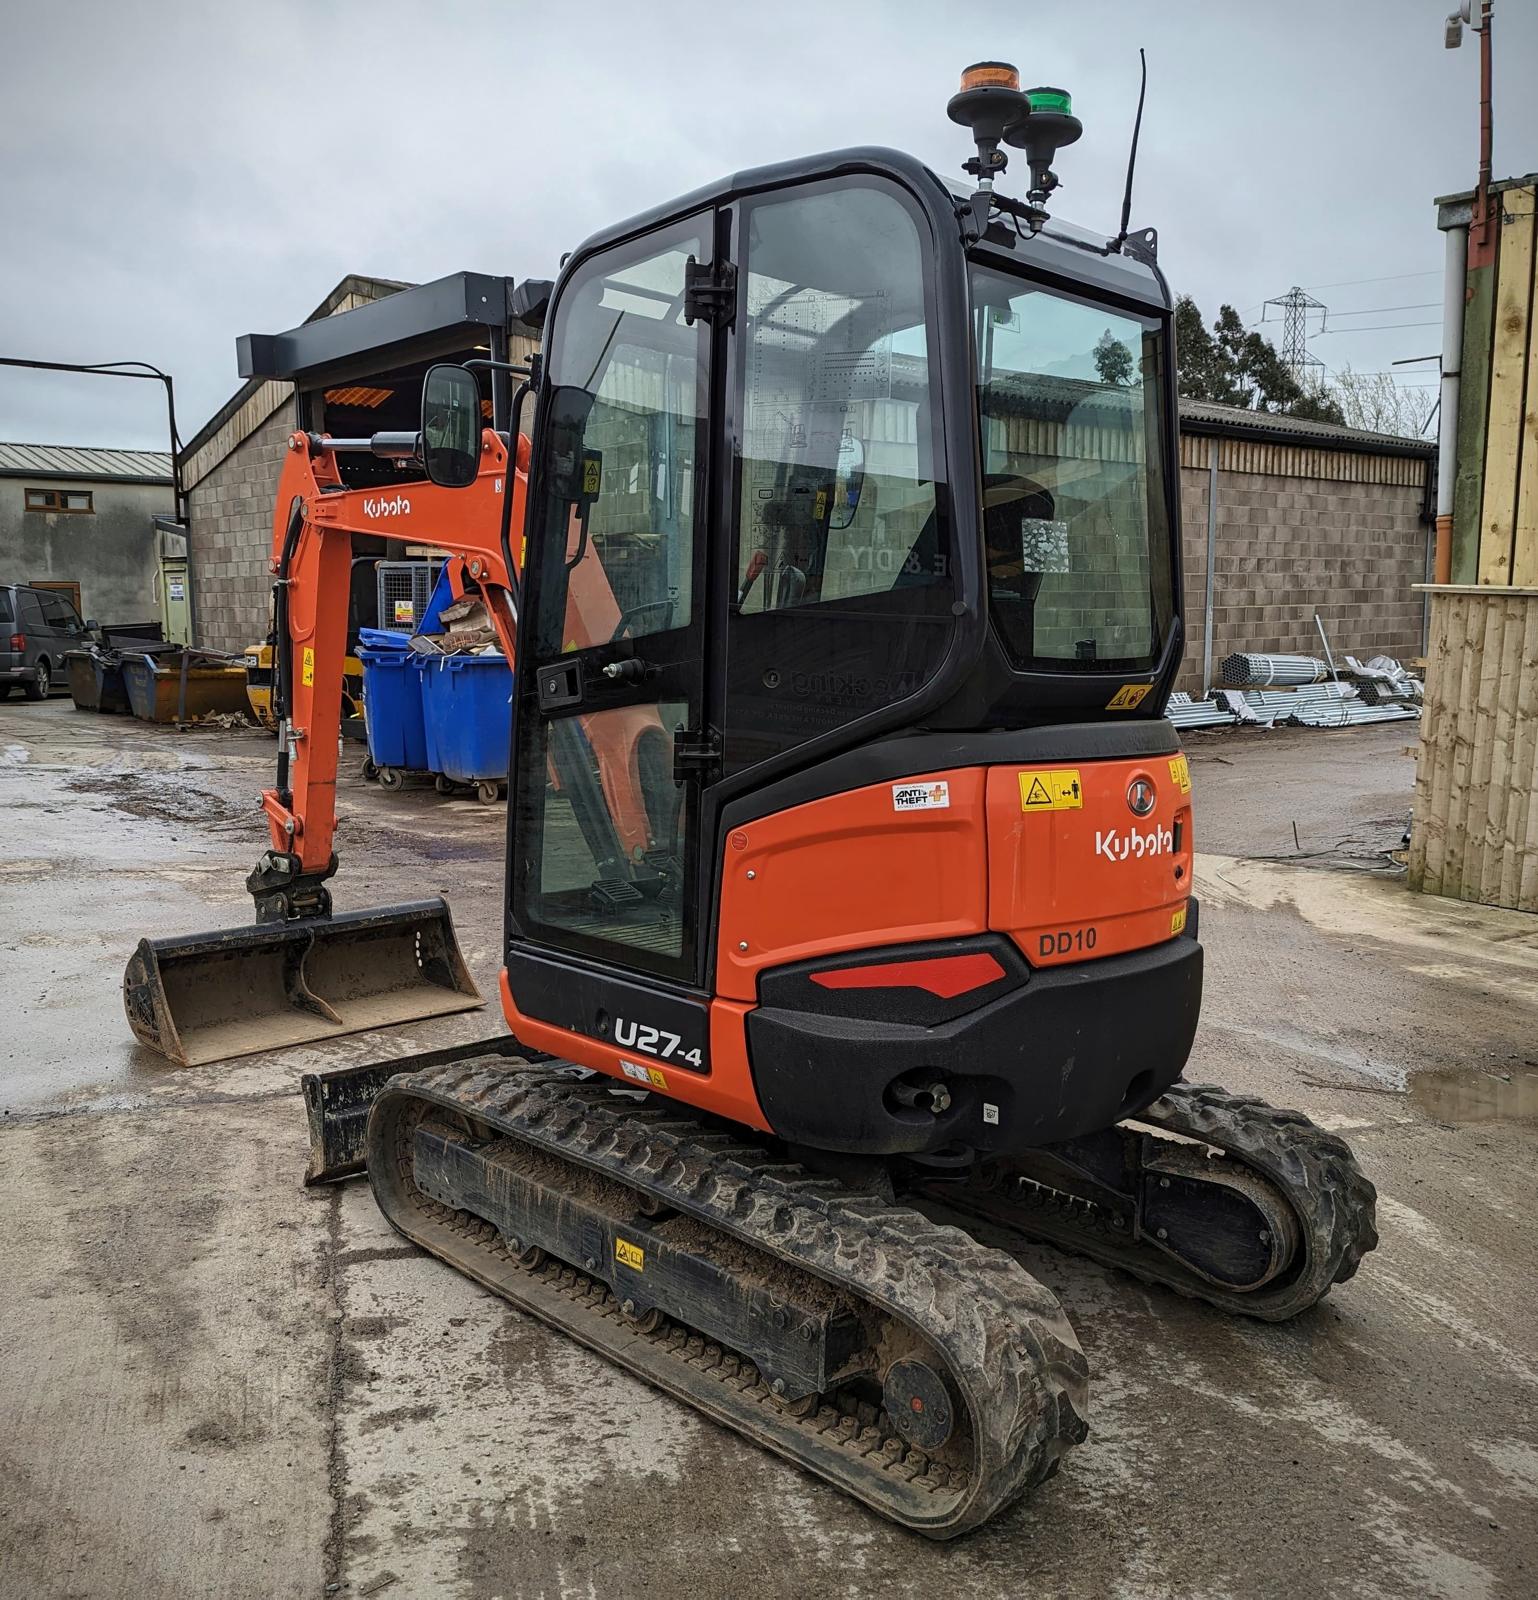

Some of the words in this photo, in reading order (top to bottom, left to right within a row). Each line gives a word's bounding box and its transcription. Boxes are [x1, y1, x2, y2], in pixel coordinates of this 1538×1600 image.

[364, 495, 410, 518] Kubota
[895, 796, 928, 806] THEFT
[896, 789, 921, 798] ANTI
[1095, 823, 1173, 862] Kubota
[1039, 928, 1097, 957] DD10
[614, 1018, 702, 1067] U27-4
